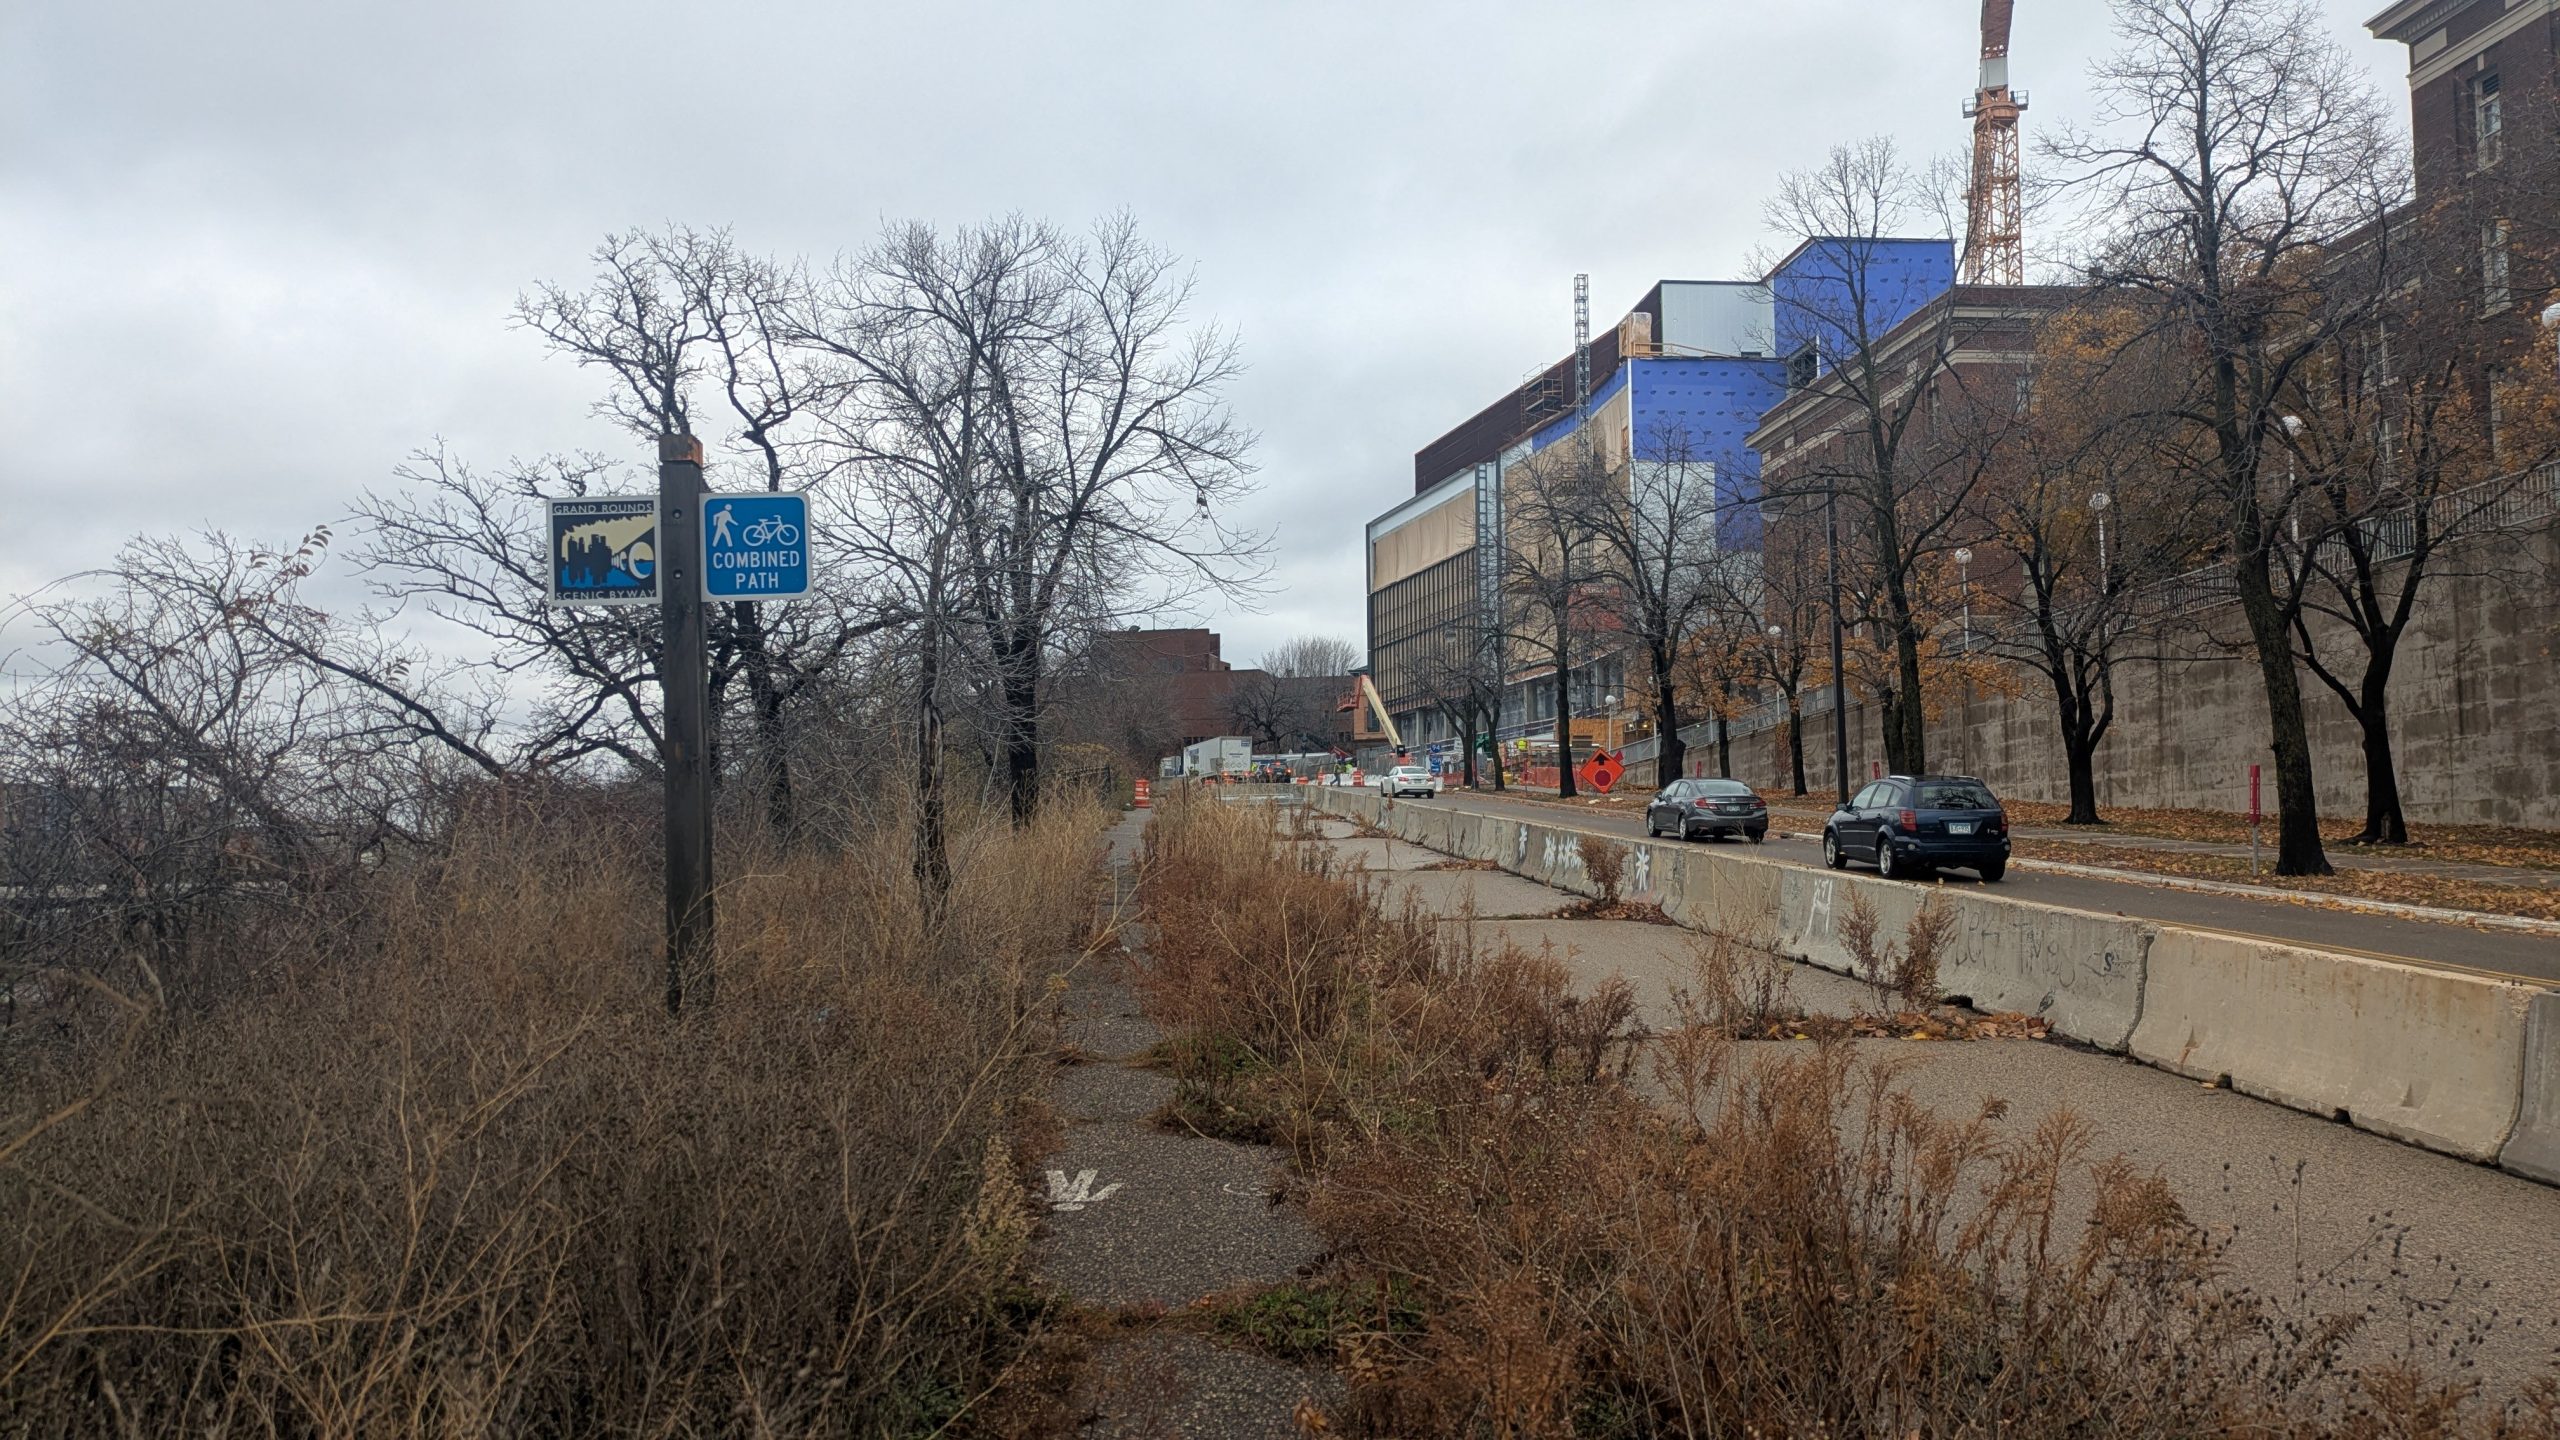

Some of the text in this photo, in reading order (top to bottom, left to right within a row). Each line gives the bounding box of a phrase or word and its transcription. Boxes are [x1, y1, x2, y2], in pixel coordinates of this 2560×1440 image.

[553, 503, 652, 514] GRAND ROUNDS
[712, 550, 800, 569] COMBINED
[735, 572, 779, 590] PATH
[556, 589, 655, 601] SCENIC BYWAY
